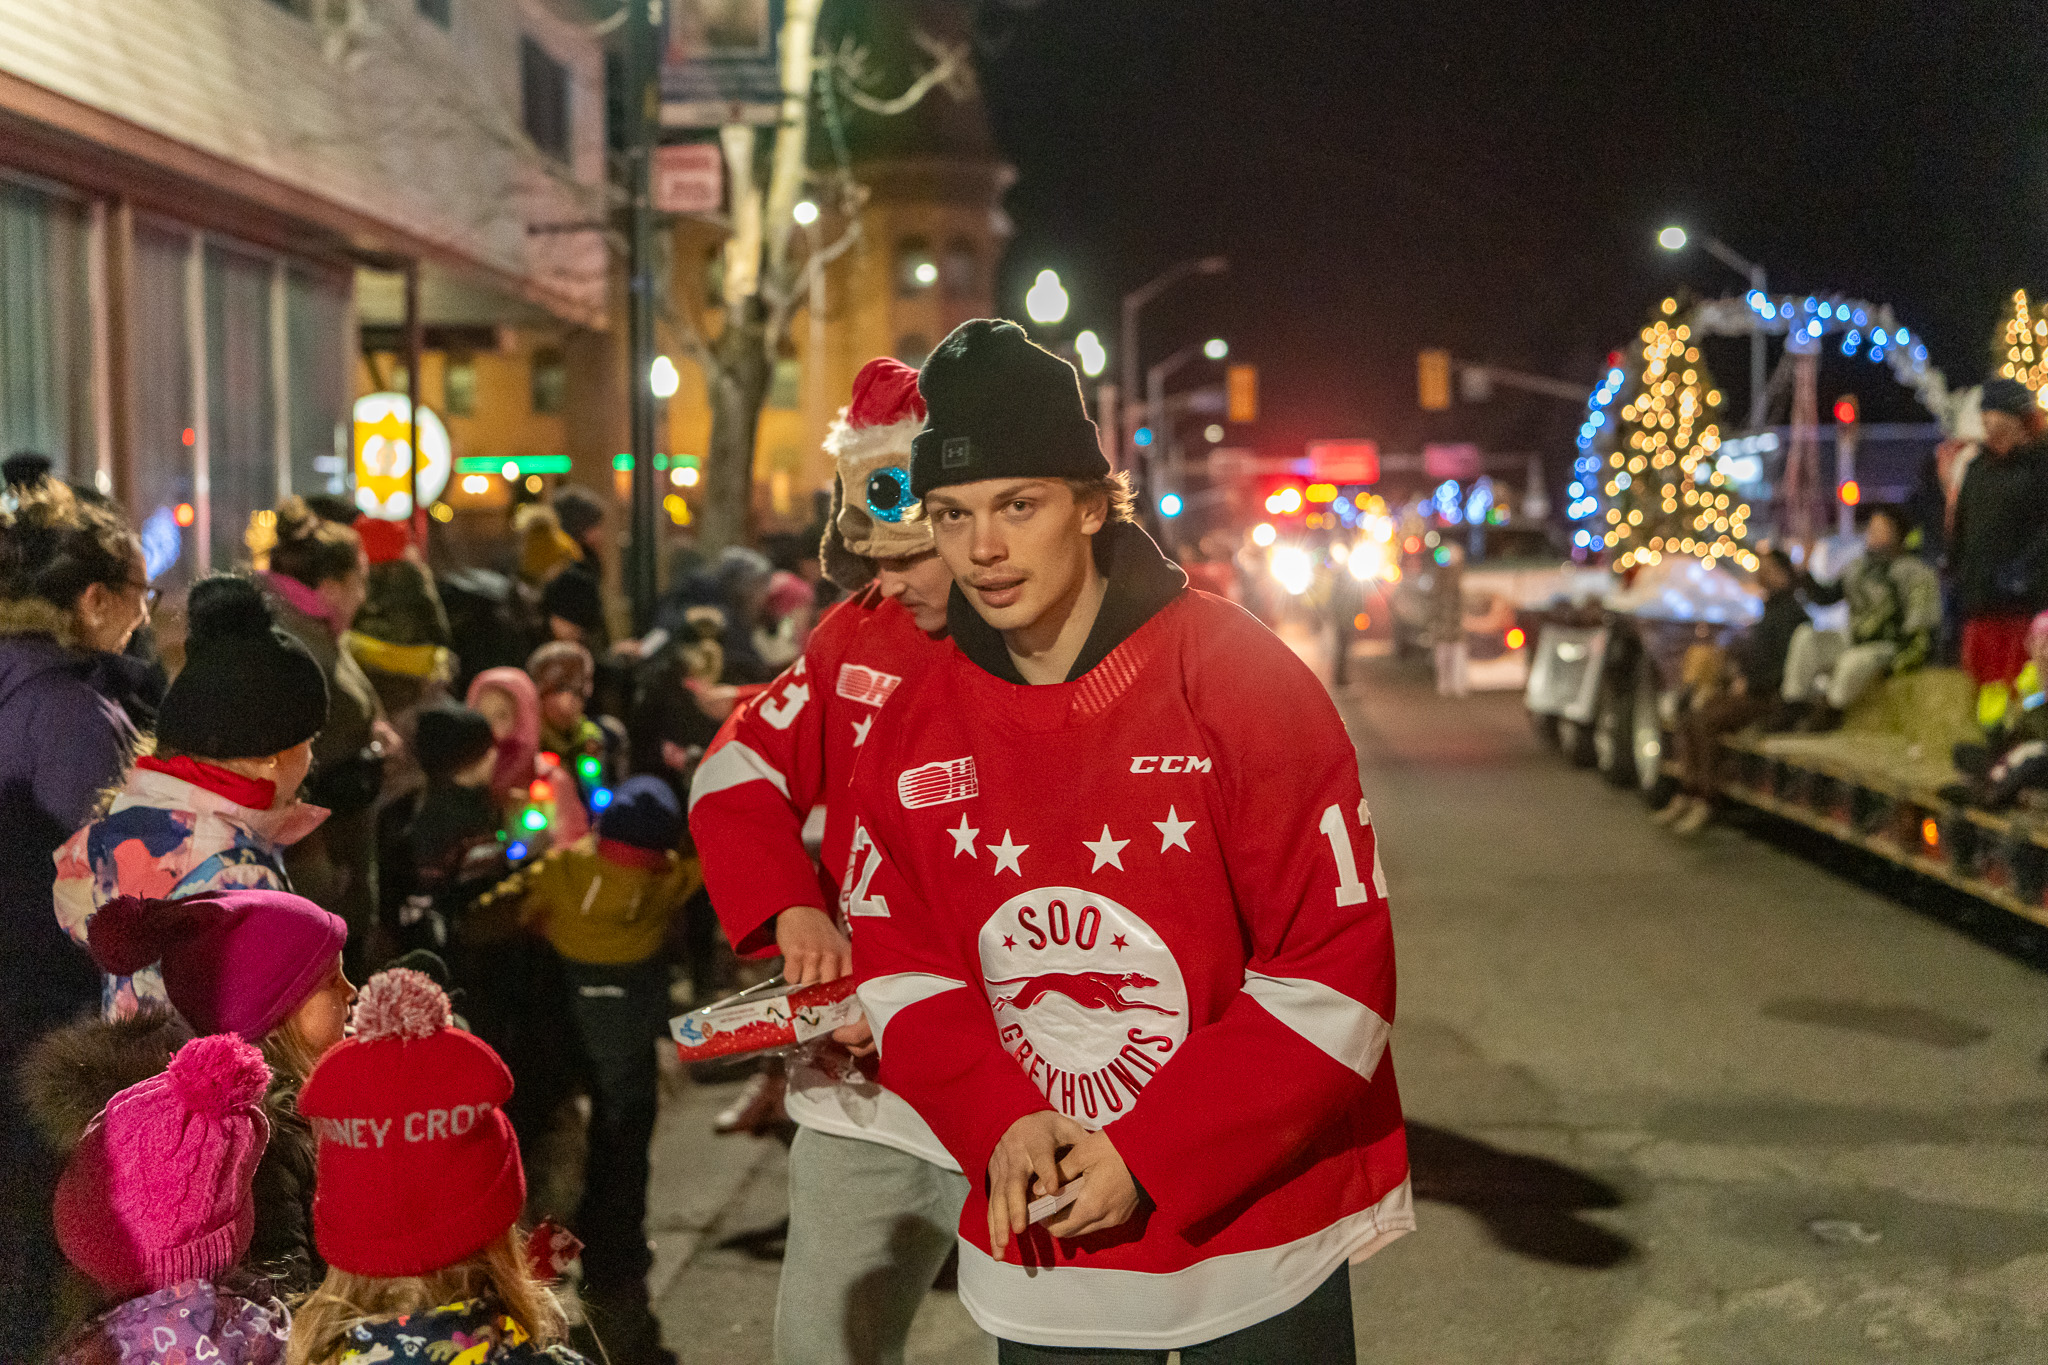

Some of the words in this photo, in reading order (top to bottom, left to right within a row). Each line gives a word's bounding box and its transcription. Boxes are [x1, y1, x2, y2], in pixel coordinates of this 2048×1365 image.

[1130, 755, 1212, 774] CCM
[1018, 899, 1101, 950] SOO
[1001, 1022, 1173, 1119] GREYHOUNDS
